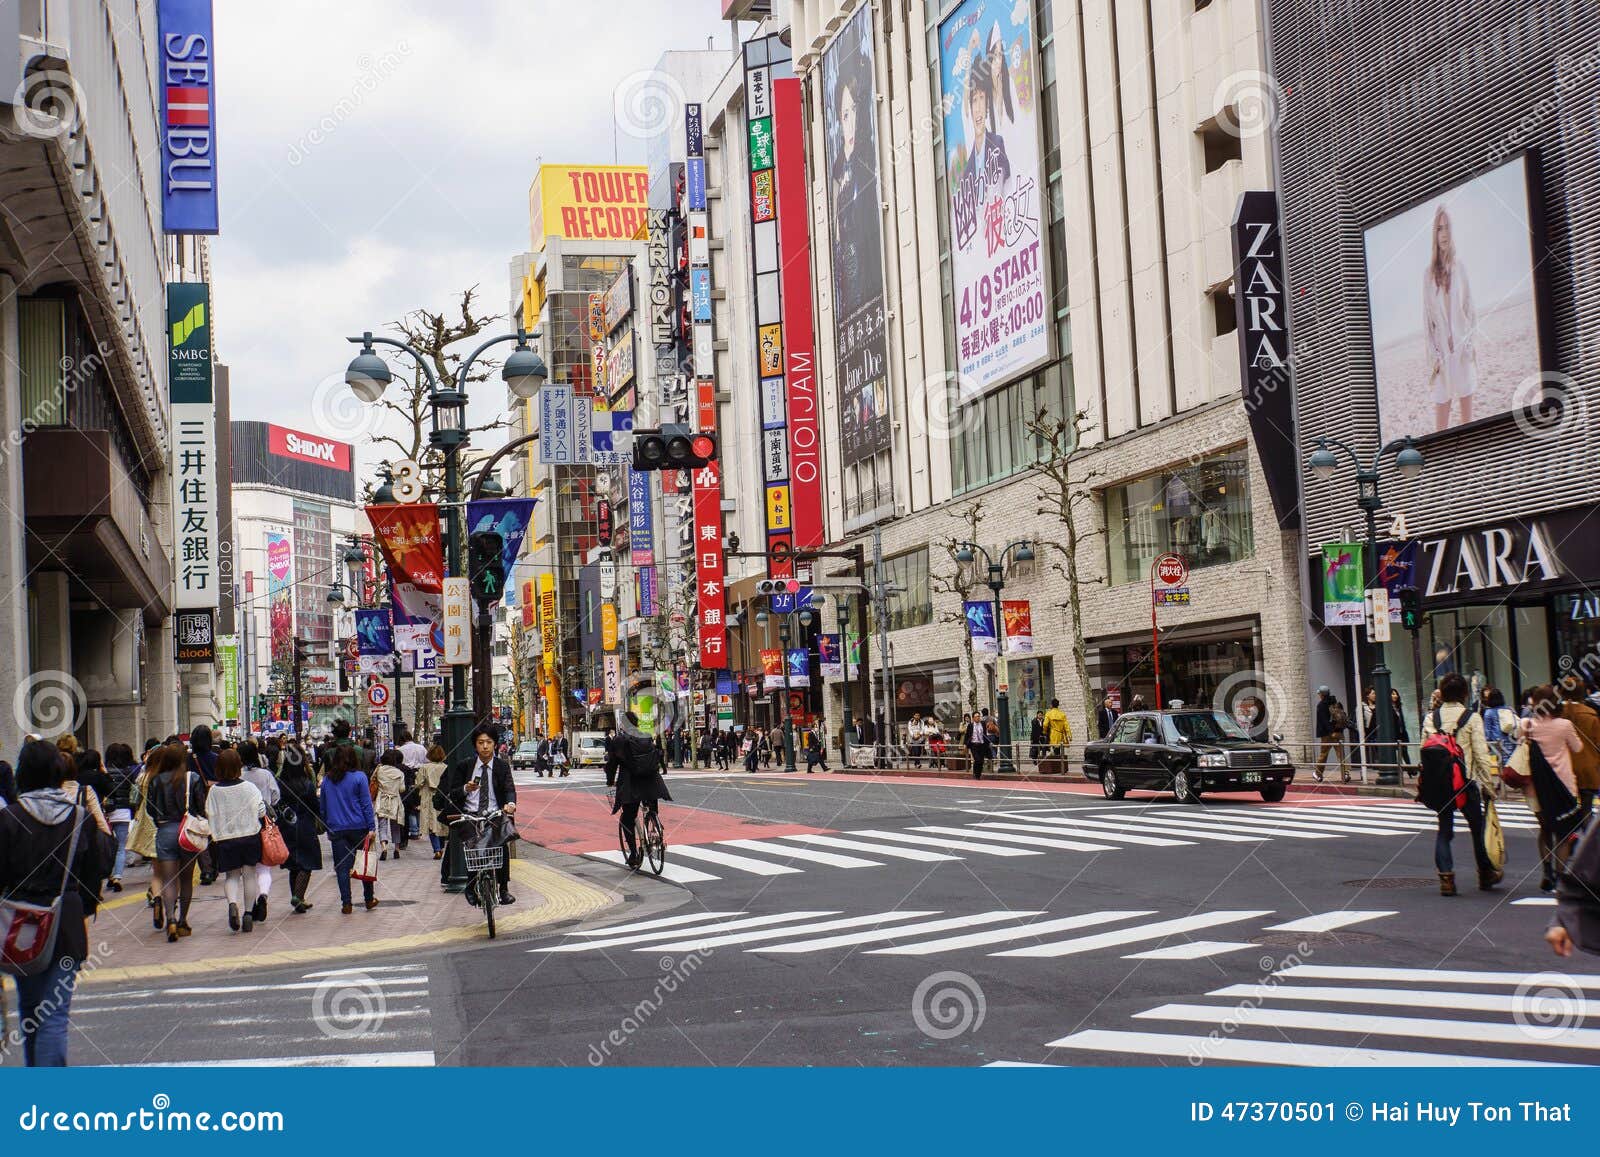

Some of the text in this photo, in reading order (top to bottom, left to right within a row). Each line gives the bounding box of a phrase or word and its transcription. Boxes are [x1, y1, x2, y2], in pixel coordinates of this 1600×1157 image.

[165, 33, 212, 196] SEIBU
[753, 71, 764, 116] 岩本ビル
[647, 208, 673, 344] KARAOKE
[960, 240, 1040, 329] 4/9 START
[1245, 223, 1285, 368] ZARA
[171, 349, 208, 360] SMBC
[845, 363, 863, 394] Jane
[554, 388, 567, 461] 井ノ頭通り入口
[577, 399, 588, 462] スクランブル交差点
[286, 433, 336, 462] SHIDAX
[594, 451, 633, 465] 時差式
[392, 459, 423, 503] 3
[630, 473, 645, 528] 渋谷整形
[179, 420, 210, 591] 三井住友銀行
[774, 504, 784, 525] 松屋
[1389, 514, 1409, 541] 4
[1160, 565, 1182, 577] 消火栓
[1423, 521, 1562, 597] ZARA
[700, 525, 722, 654] 東日本銀行
[1571, 598, 1600, 620] ZA
[179, 648, 212, 658] alook
